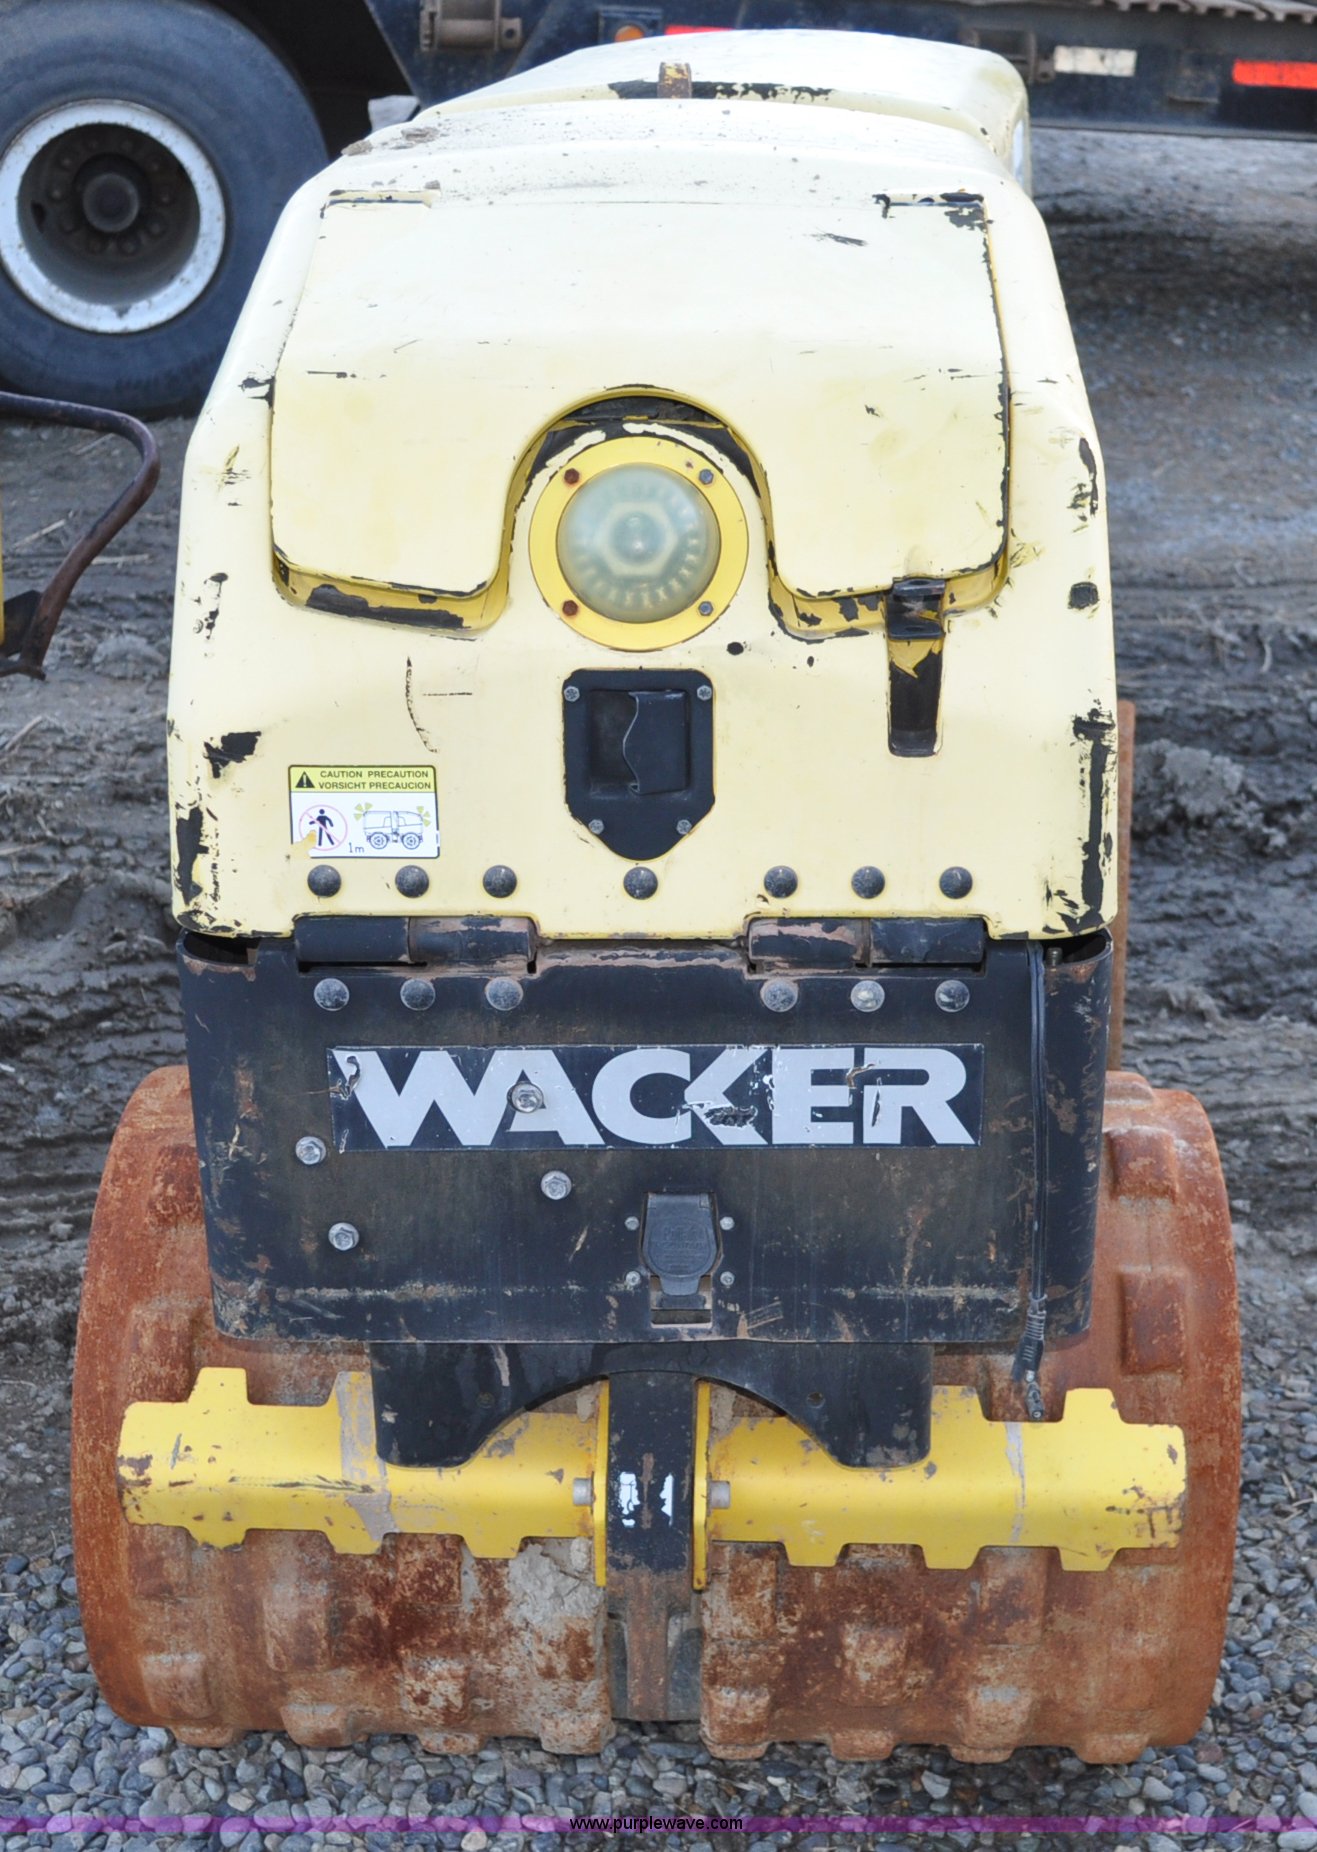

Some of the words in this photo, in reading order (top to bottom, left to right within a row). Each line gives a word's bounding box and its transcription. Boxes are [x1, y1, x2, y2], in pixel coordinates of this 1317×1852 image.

[320, 770, 363, 778] CAUTION
[367, 770, 429, 778] PRECAUTION
[318, 781, 366, 789] VORSICHT
[369, 781, 431, 789] PRECAUCION
[333, 1047, 976, 1146] WACKER
